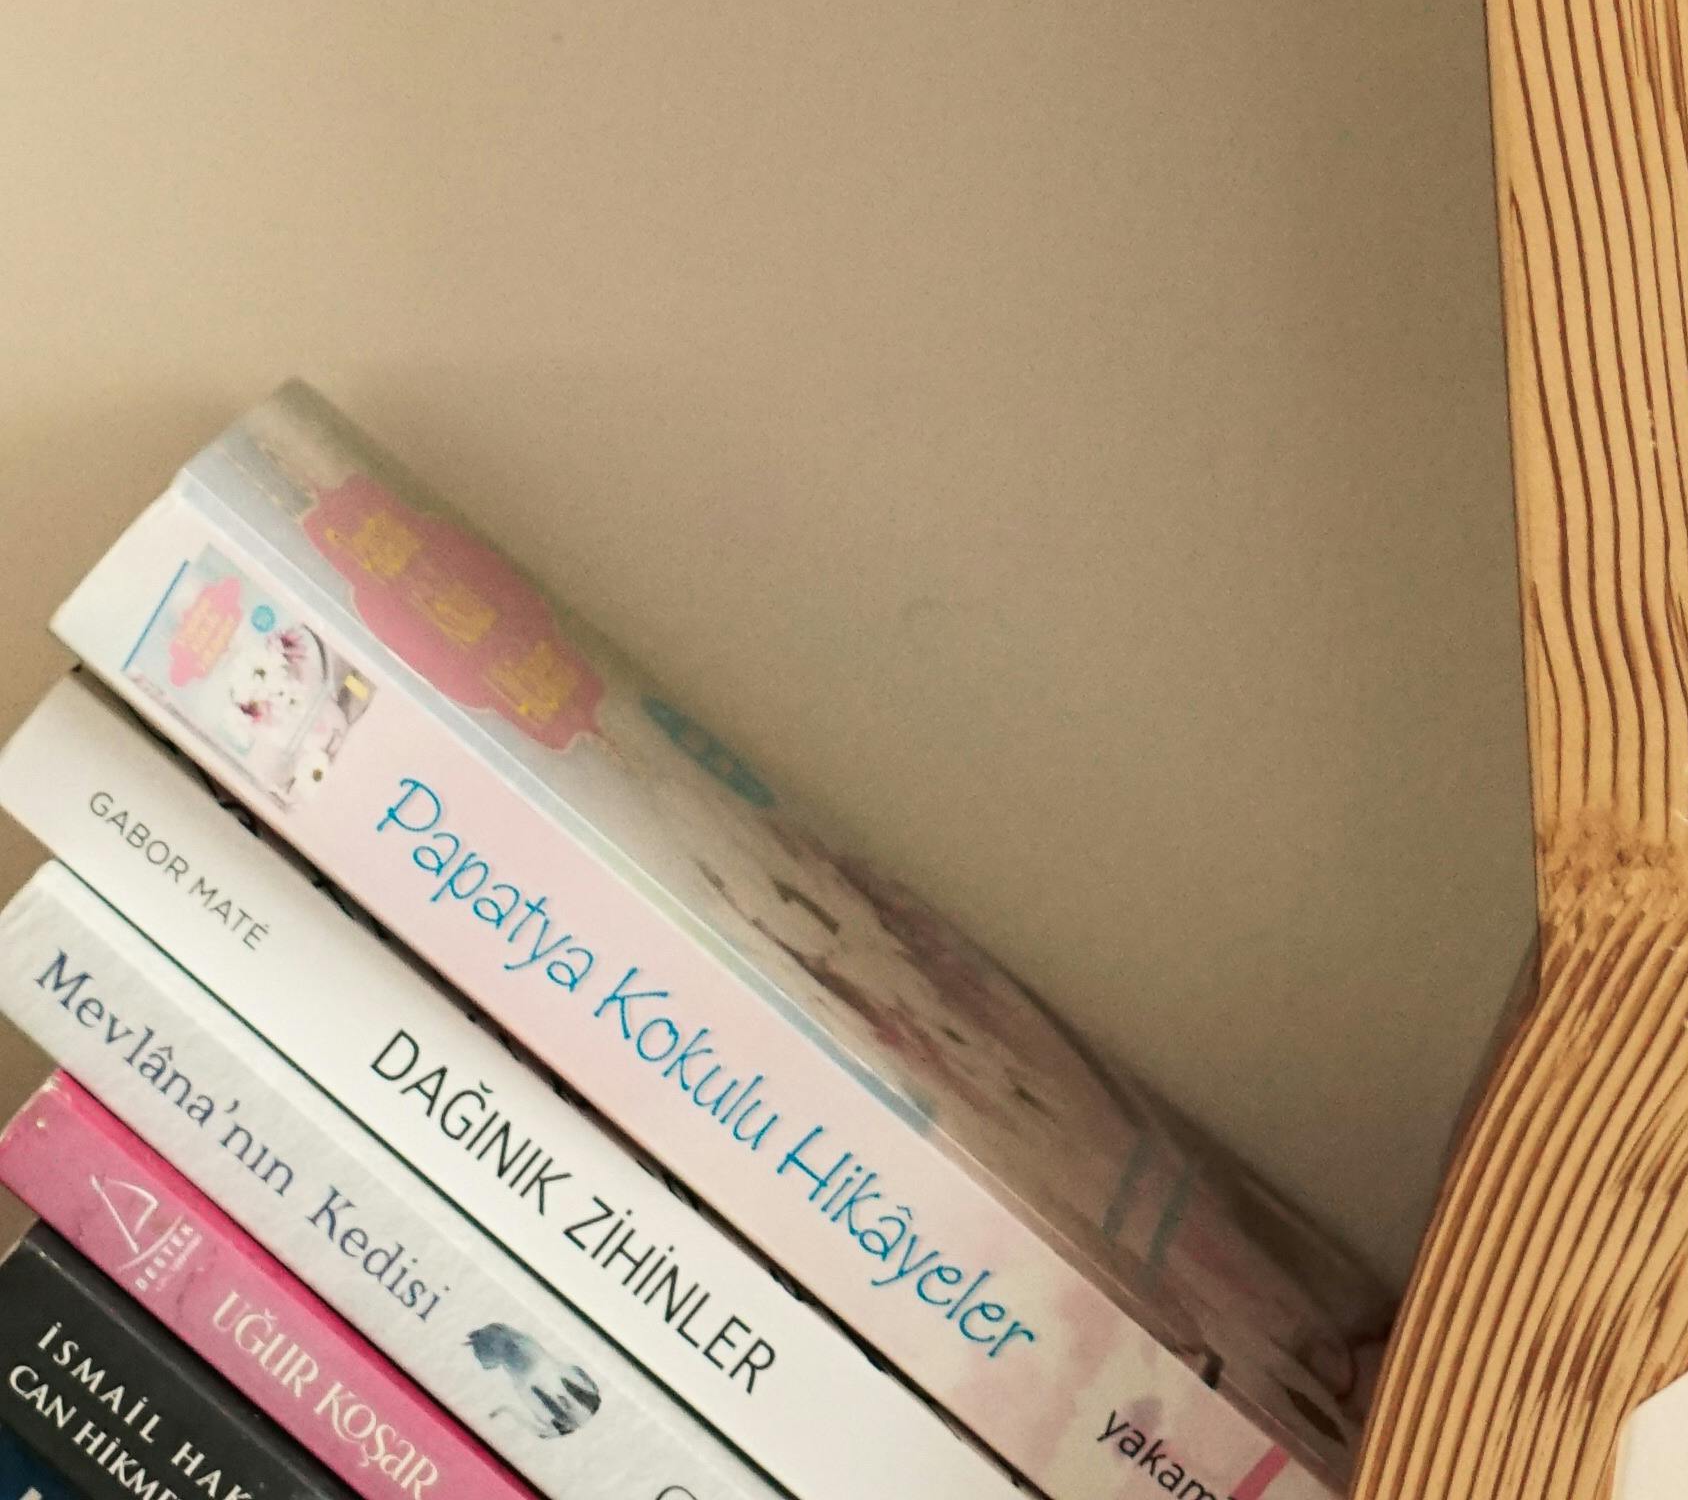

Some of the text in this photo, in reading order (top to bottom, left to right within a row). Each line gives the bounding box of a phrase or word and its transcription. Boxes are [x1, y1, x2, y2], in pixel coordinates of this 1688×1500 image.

[88, 789, 271, 953] GABOR MATÉ
[376, 775, 1036, 1362] Papatya Kokulu Hikâyeler
[305, 1183, 452, 1324] Kedisi
[369, 1027, 778, 1396] DAĞINIK ZİHİNLER
[9, 1365, 78, 1430] CAN
[37, 1321, 162, 1444] İSMAİL
[1096, 1409, 1236, 1500] yakam
